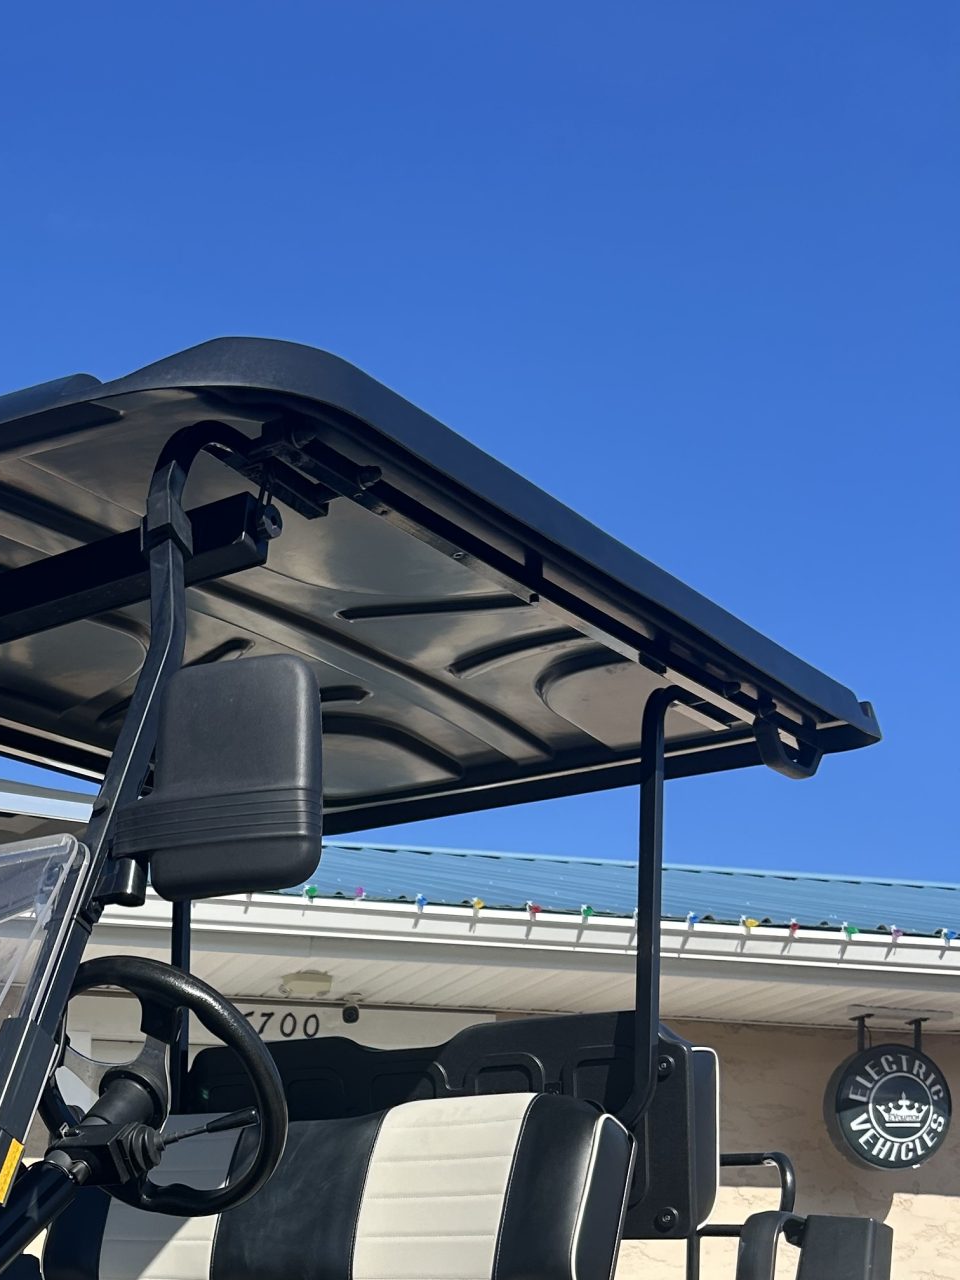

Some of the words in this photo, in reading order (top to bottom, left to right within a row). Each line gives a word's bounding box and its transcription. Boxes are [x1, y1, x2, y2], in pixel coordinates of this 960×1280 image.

[243, 1010, 320, 1038] 700
[848, 1054, 944, 1102] ELECTRIC
[850, 1112, 945, 1161] VEHICLES
